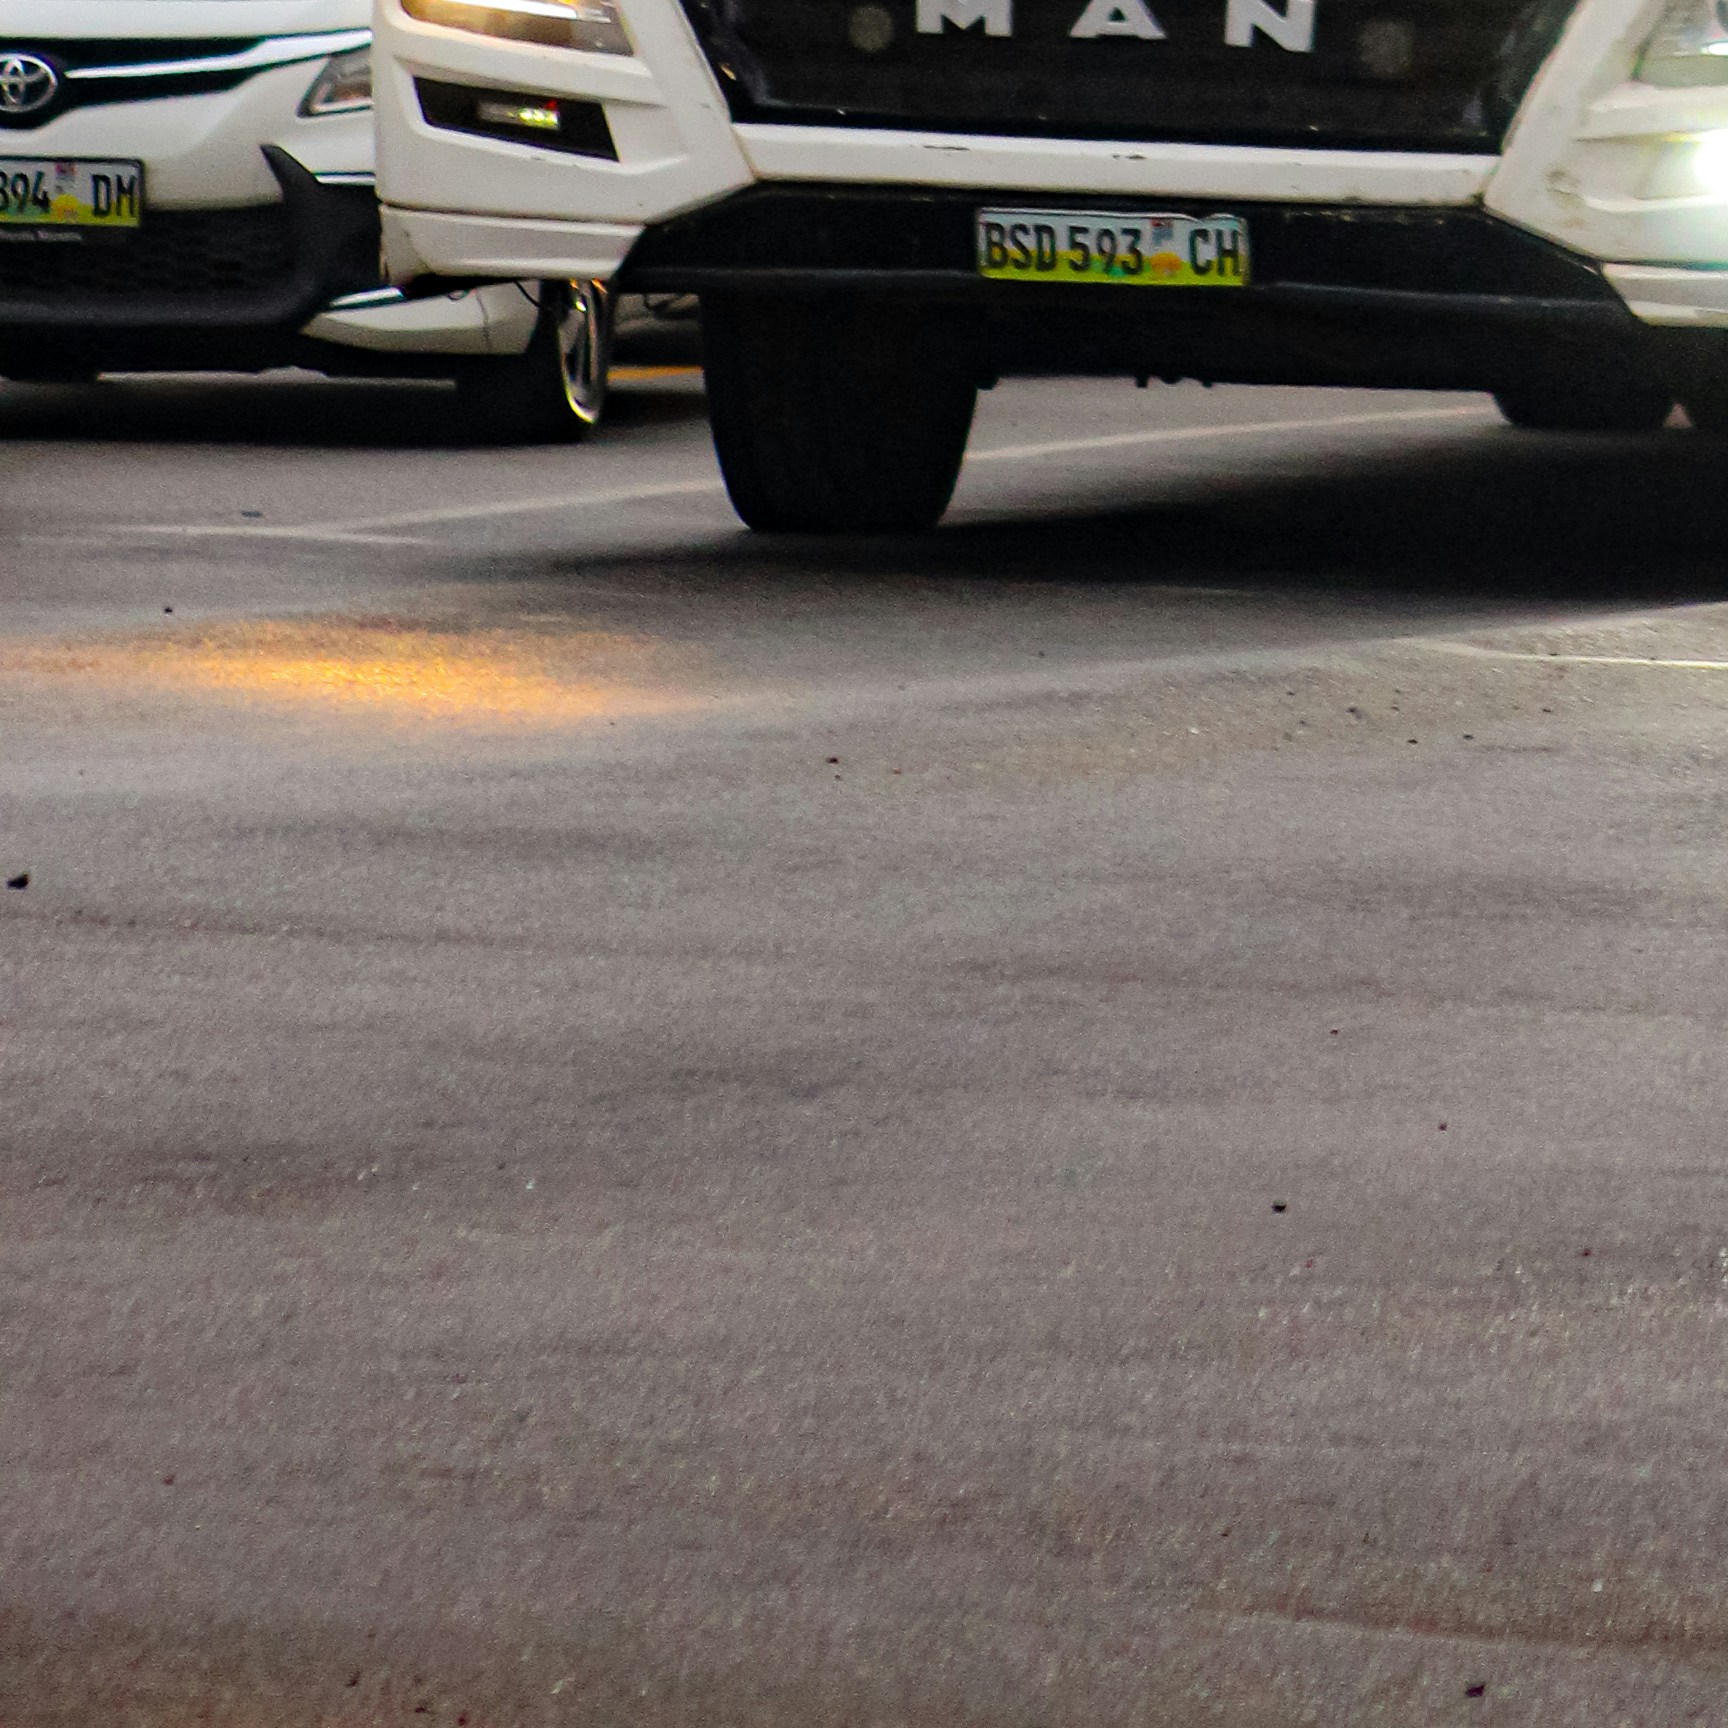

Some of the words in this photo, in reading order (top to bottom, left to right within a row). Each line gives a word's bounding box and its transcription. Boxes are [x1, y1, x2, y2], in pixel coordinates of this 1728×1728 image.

[92, 173, 137, 218] DM
[985, 222, 1057, 272] BSD
[1067, 225, 1144, 276] 593
[1189, 228, 1241, 277] CH
